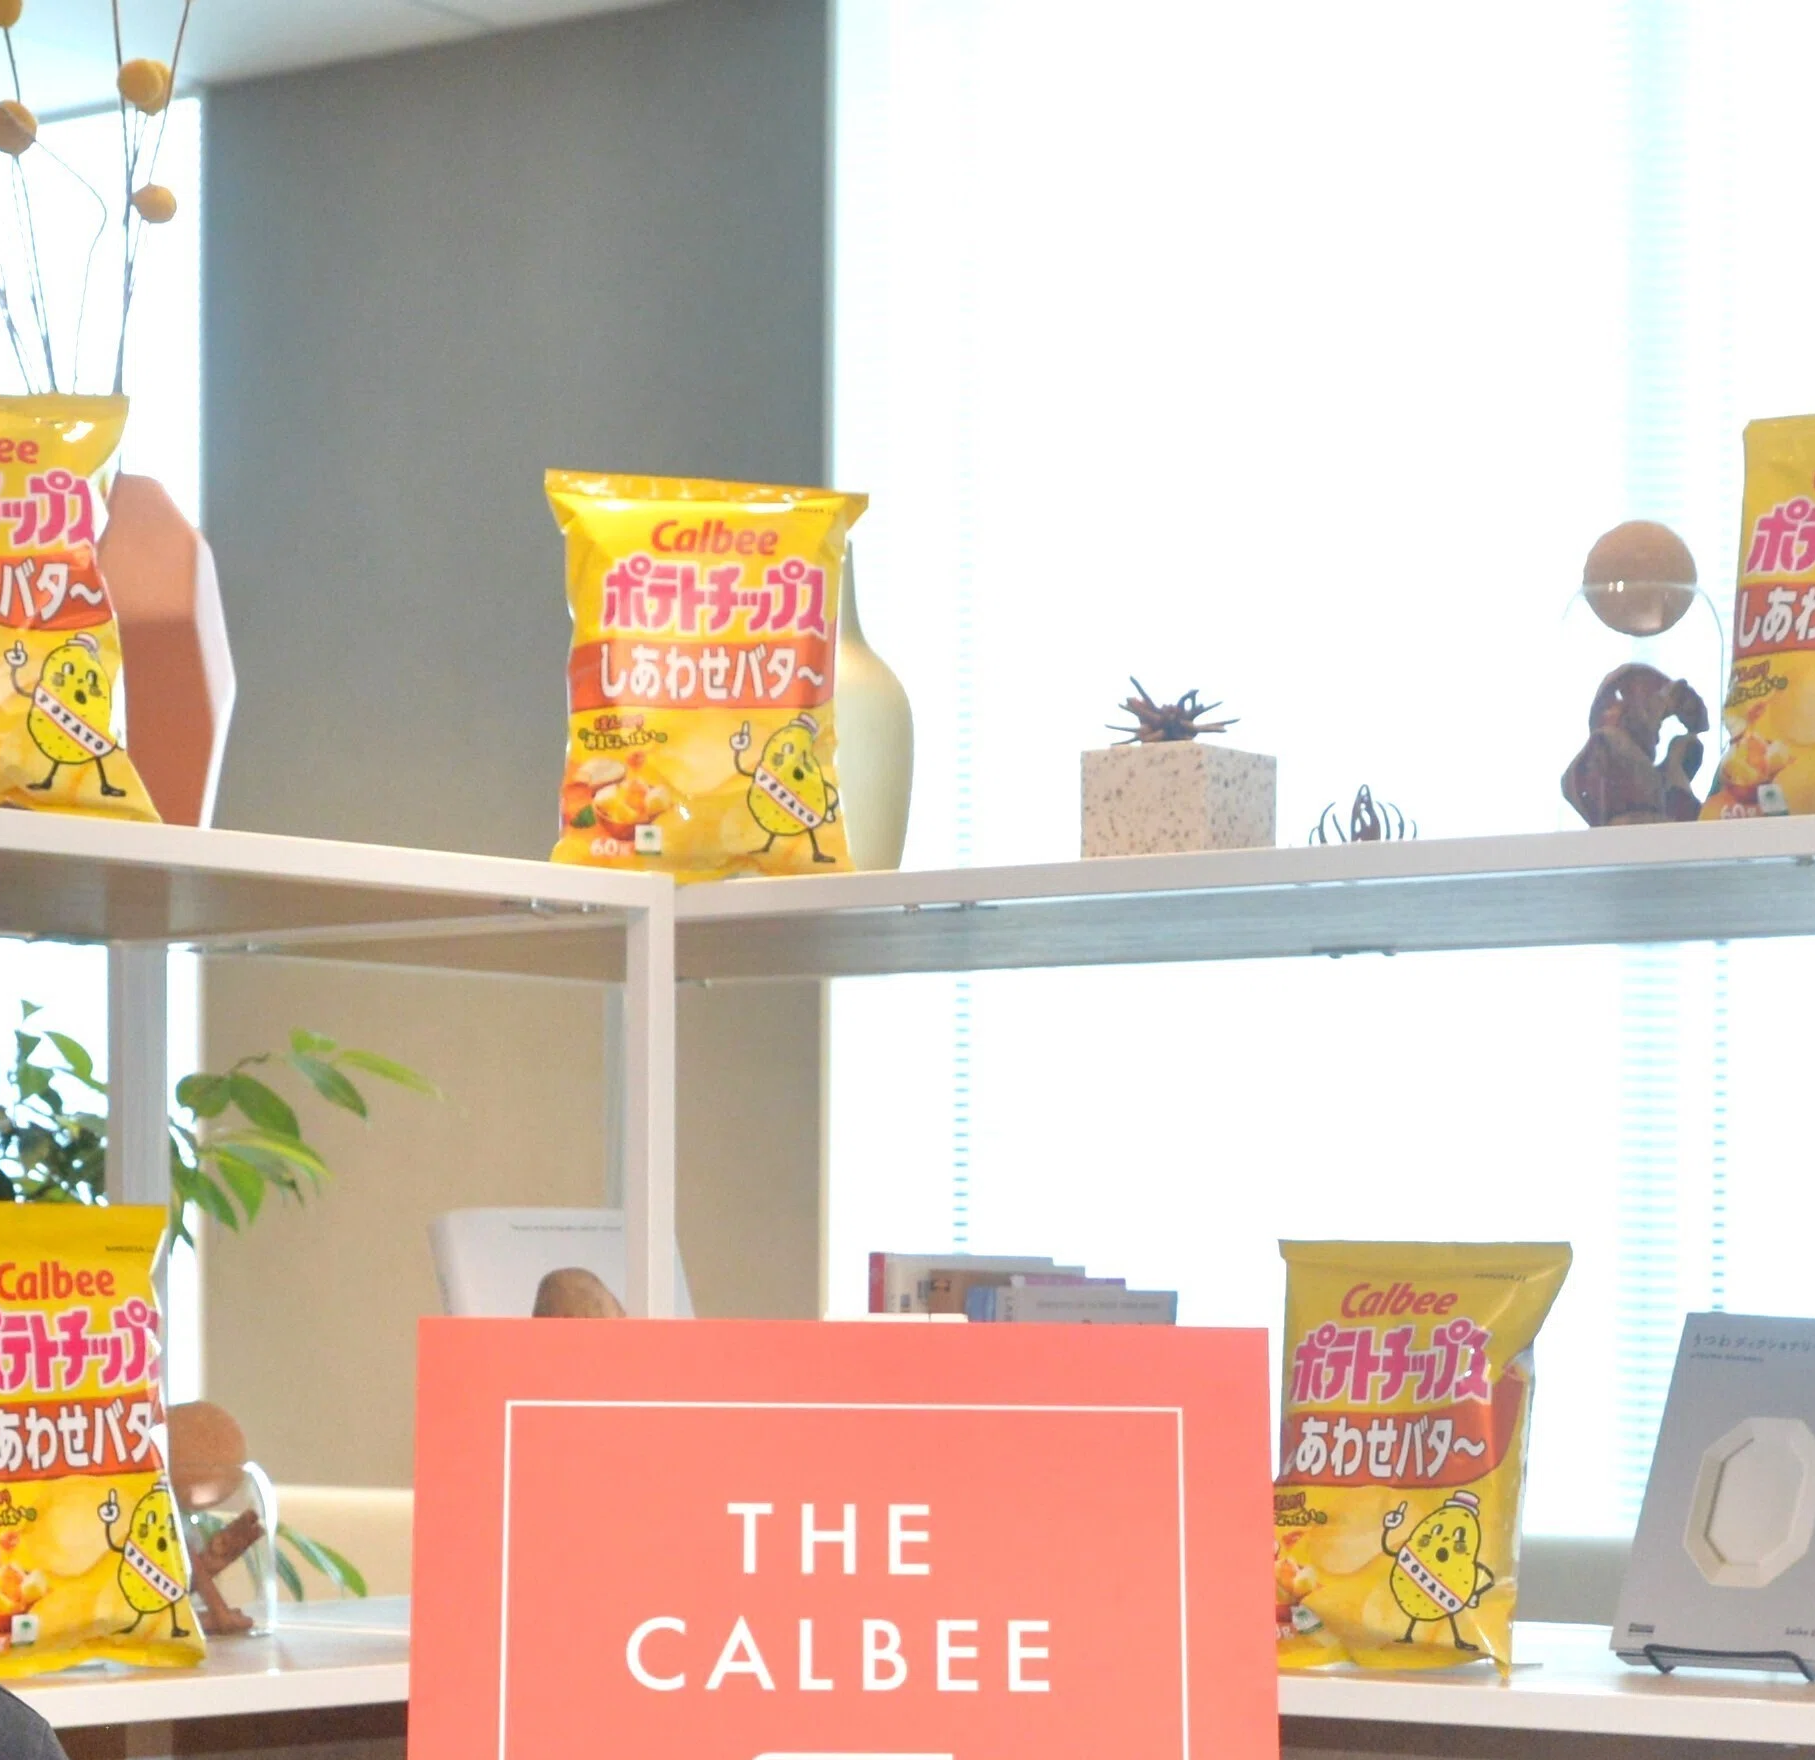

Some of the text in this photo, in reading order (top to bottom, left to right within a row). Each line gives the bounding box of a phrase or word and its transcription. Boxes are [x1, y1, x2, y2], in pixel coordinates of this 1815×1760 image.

[651, 520, 779, 556] Calbee
[602, 556, 827, 641] ポテトチップス
[601, 643, 824, 700] しあわせバタ〜
[36, 692, 105, 754] POTATO
[756, 771, 816, 824] POTATO
[1340, 1282, 1459, 1319] Calbee
[1293, 1320, 1493, 1405] ポテトチップス
[727, 1502, 932, 1576] THE
[124, 1546, 180, 1598] POTATO
[1400, 1551, 1457, 1609] POTATO
[624, 1615, 1052, 1693] CALBEE
